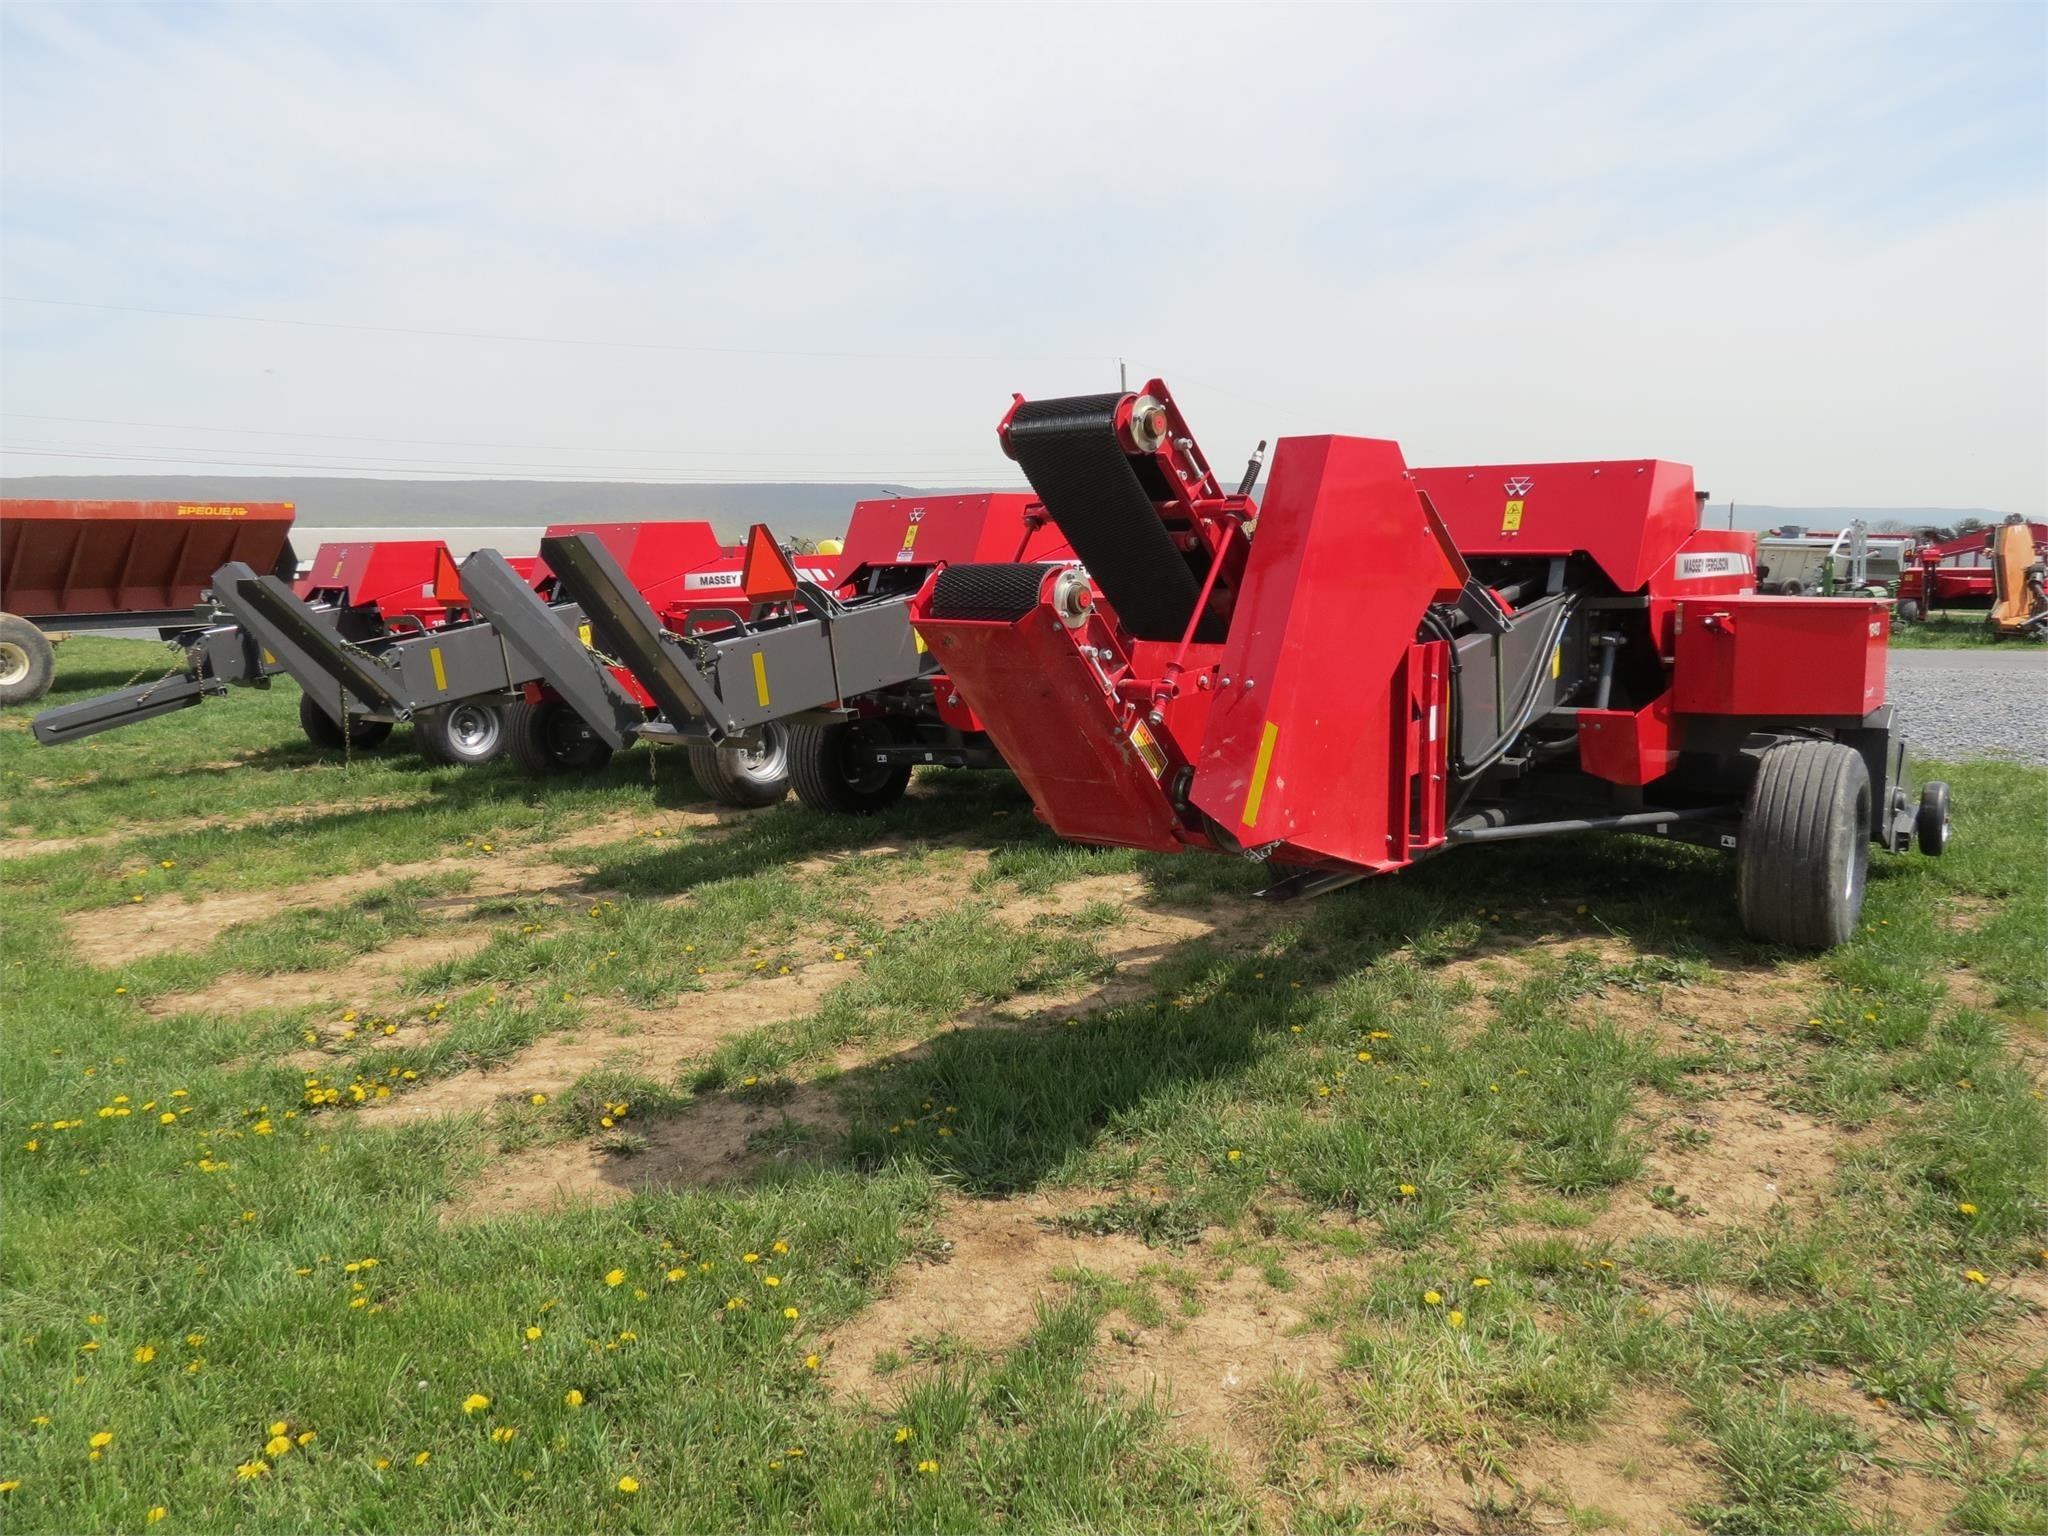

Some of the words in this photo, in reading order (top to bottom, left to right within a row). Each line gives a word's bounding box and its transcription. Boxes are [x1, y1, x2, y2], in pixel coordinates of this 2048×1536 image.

[1684, 559, 1704, 574] MASSEY
[1705, 557, 1729, 572] FERGUSON
[700, 575, 737, 586] MASSEY
